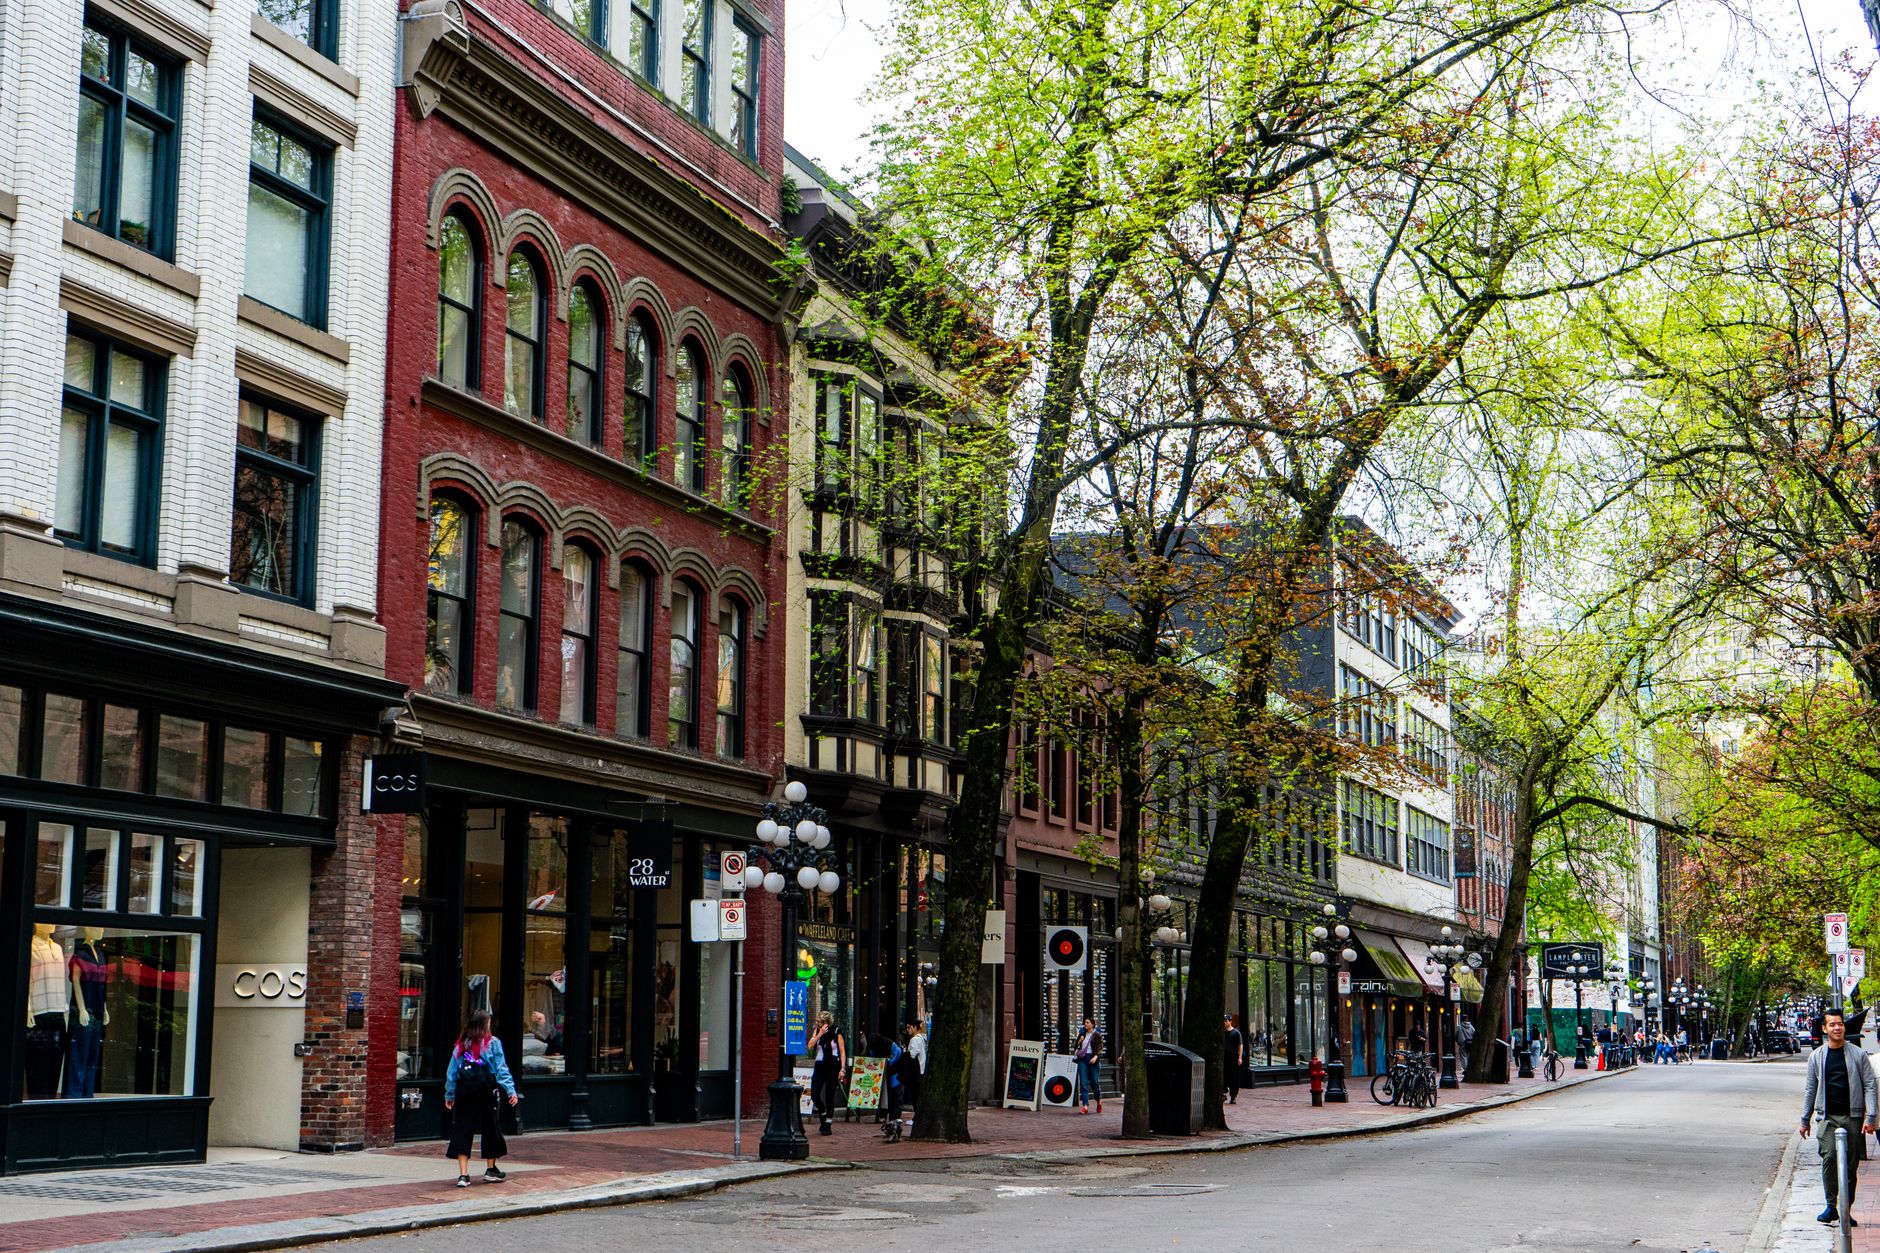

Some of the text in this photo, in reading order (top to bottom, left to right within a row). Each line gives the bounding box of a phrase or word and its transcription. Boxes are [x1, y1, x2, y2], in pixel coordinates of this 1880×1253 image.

[376, 775, 418, 792] COS
[629, 858, 655, 876] 28
[629, 875, 667, 886] WATER
[803, 923, 837, 940] WAFFLELAND
[983, 932, 1002, 942] ers
[233, 971, 306, 999] COS
[1012, 1045, 1040, 1054] makers
